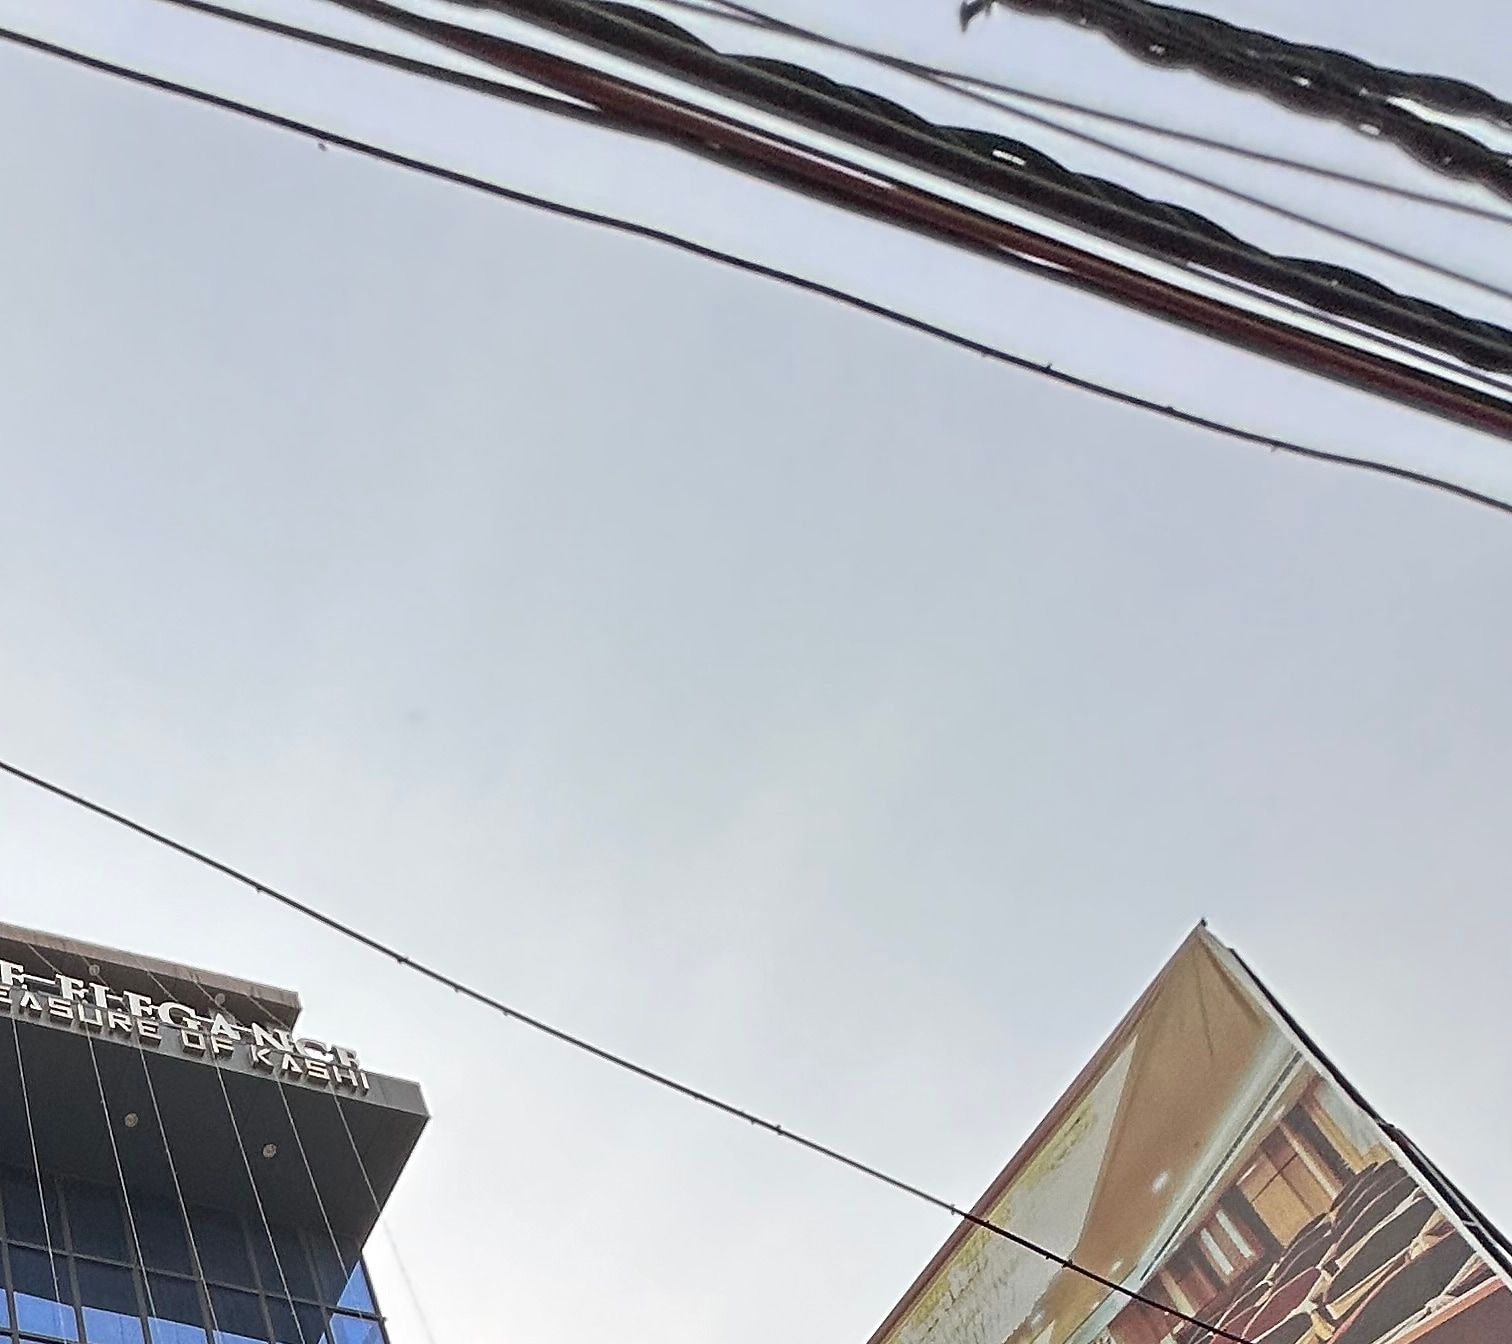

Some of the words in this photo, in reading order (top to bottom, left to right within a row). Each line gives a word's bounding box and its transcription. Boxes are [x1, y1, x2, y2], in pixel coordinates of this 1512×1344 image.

[55, 973, 360, 1069] ELEGANCE
[180, 1028, 236, 1056] OF
[248, 1043, 370, 1093] KASHI
